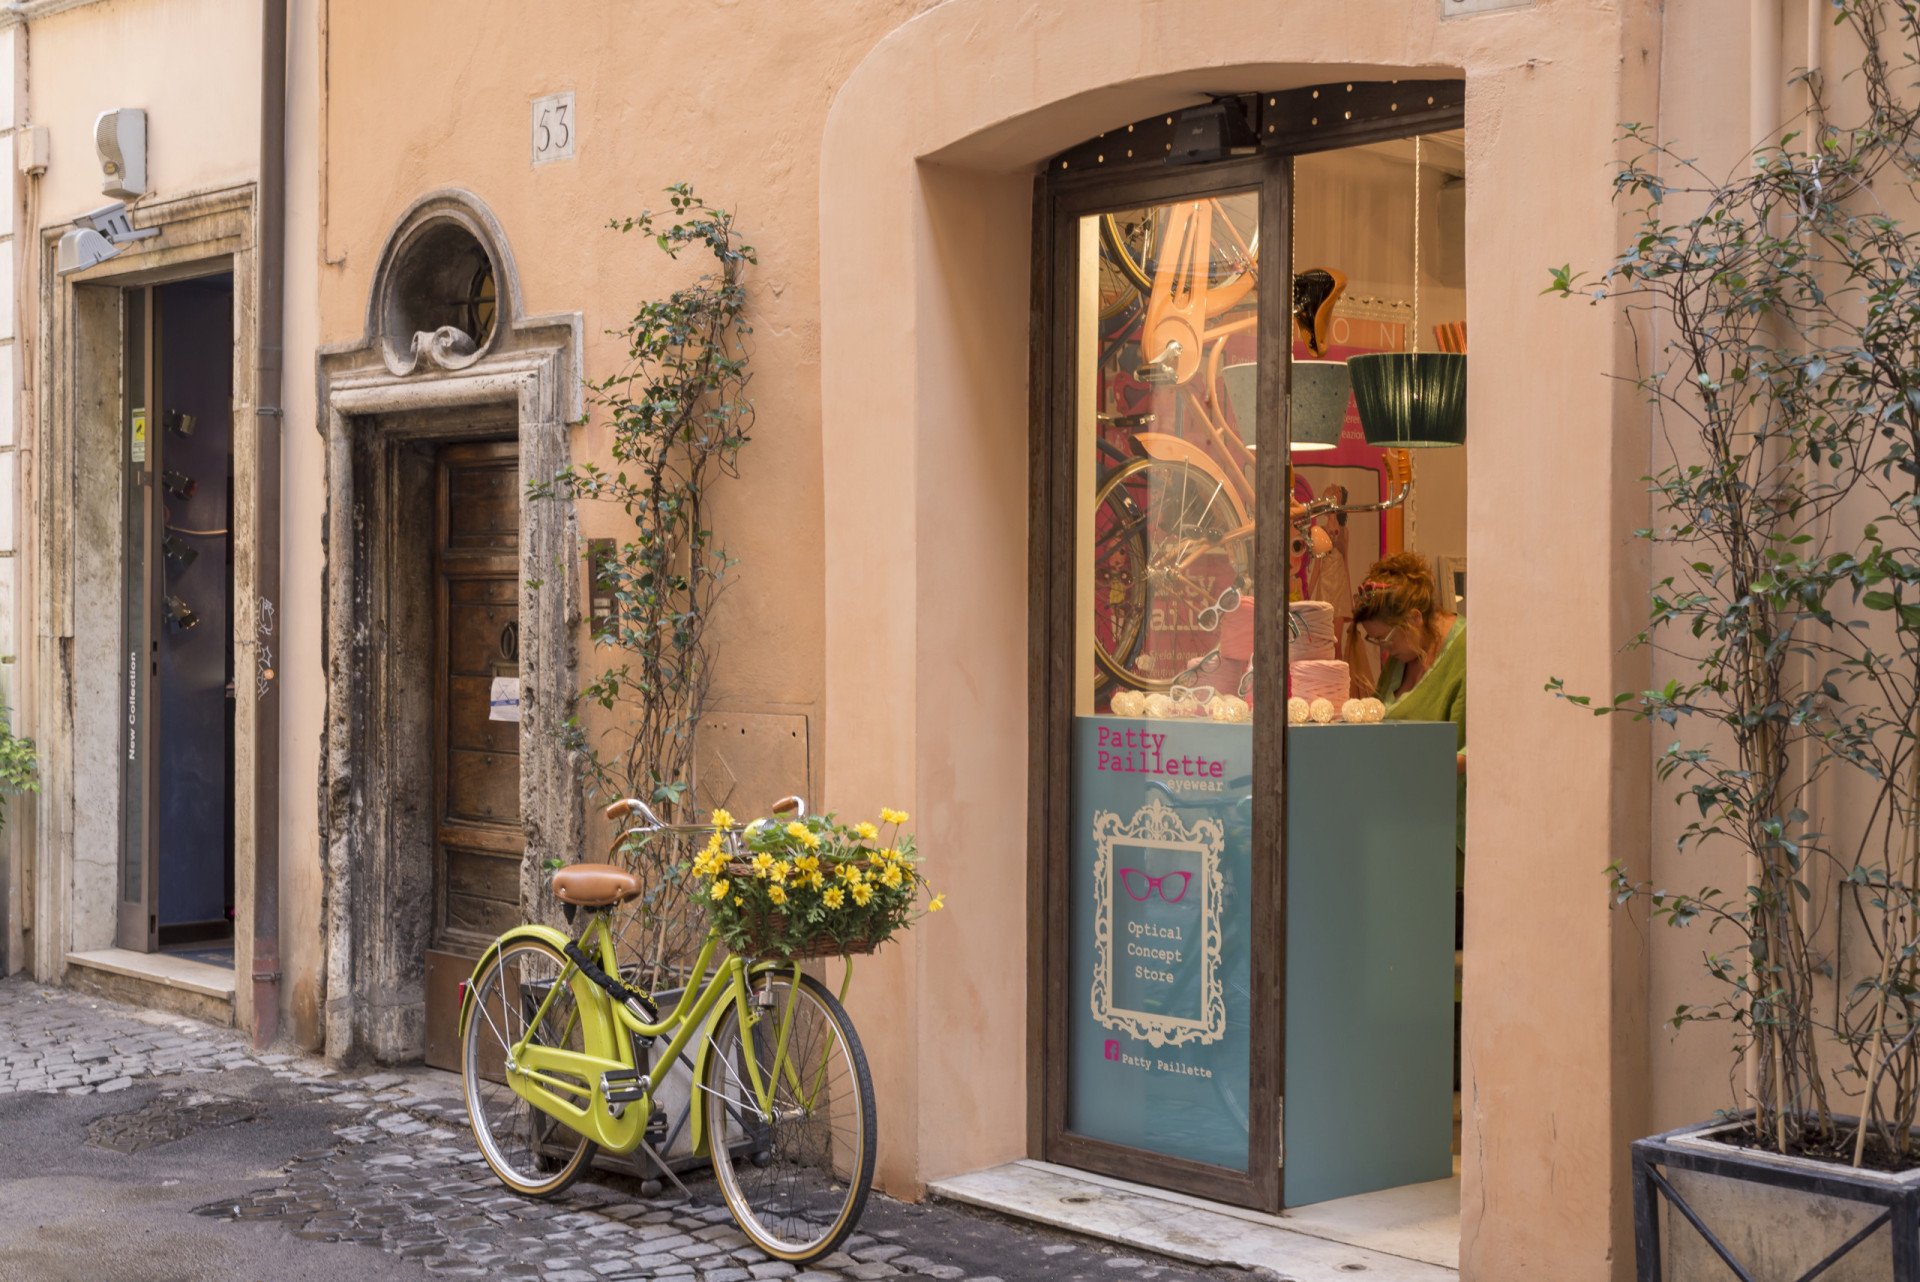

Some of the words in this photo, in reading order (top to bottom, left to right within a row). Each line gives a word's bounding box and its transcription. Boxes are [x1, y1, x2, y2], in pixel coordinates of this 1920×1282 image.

[537, 104, 569, 153] 53
[128, 652, 137, 725] Collection
[128, 728, 137, 760] New
[1096, 725, 1166, 756] Patty
[1096, 750, 1224, 778] Paillette
[1167, 779, 1224, 793] eyewear
[1127, 920, 1183, 940] Optical
[1127, 942, 1183, 965] Concept
[1135, 965, 1174, 983] Store
[1122, 1053, 1152, 1072] Patty
[1157, 1059, 1213, 1079] Paillette
